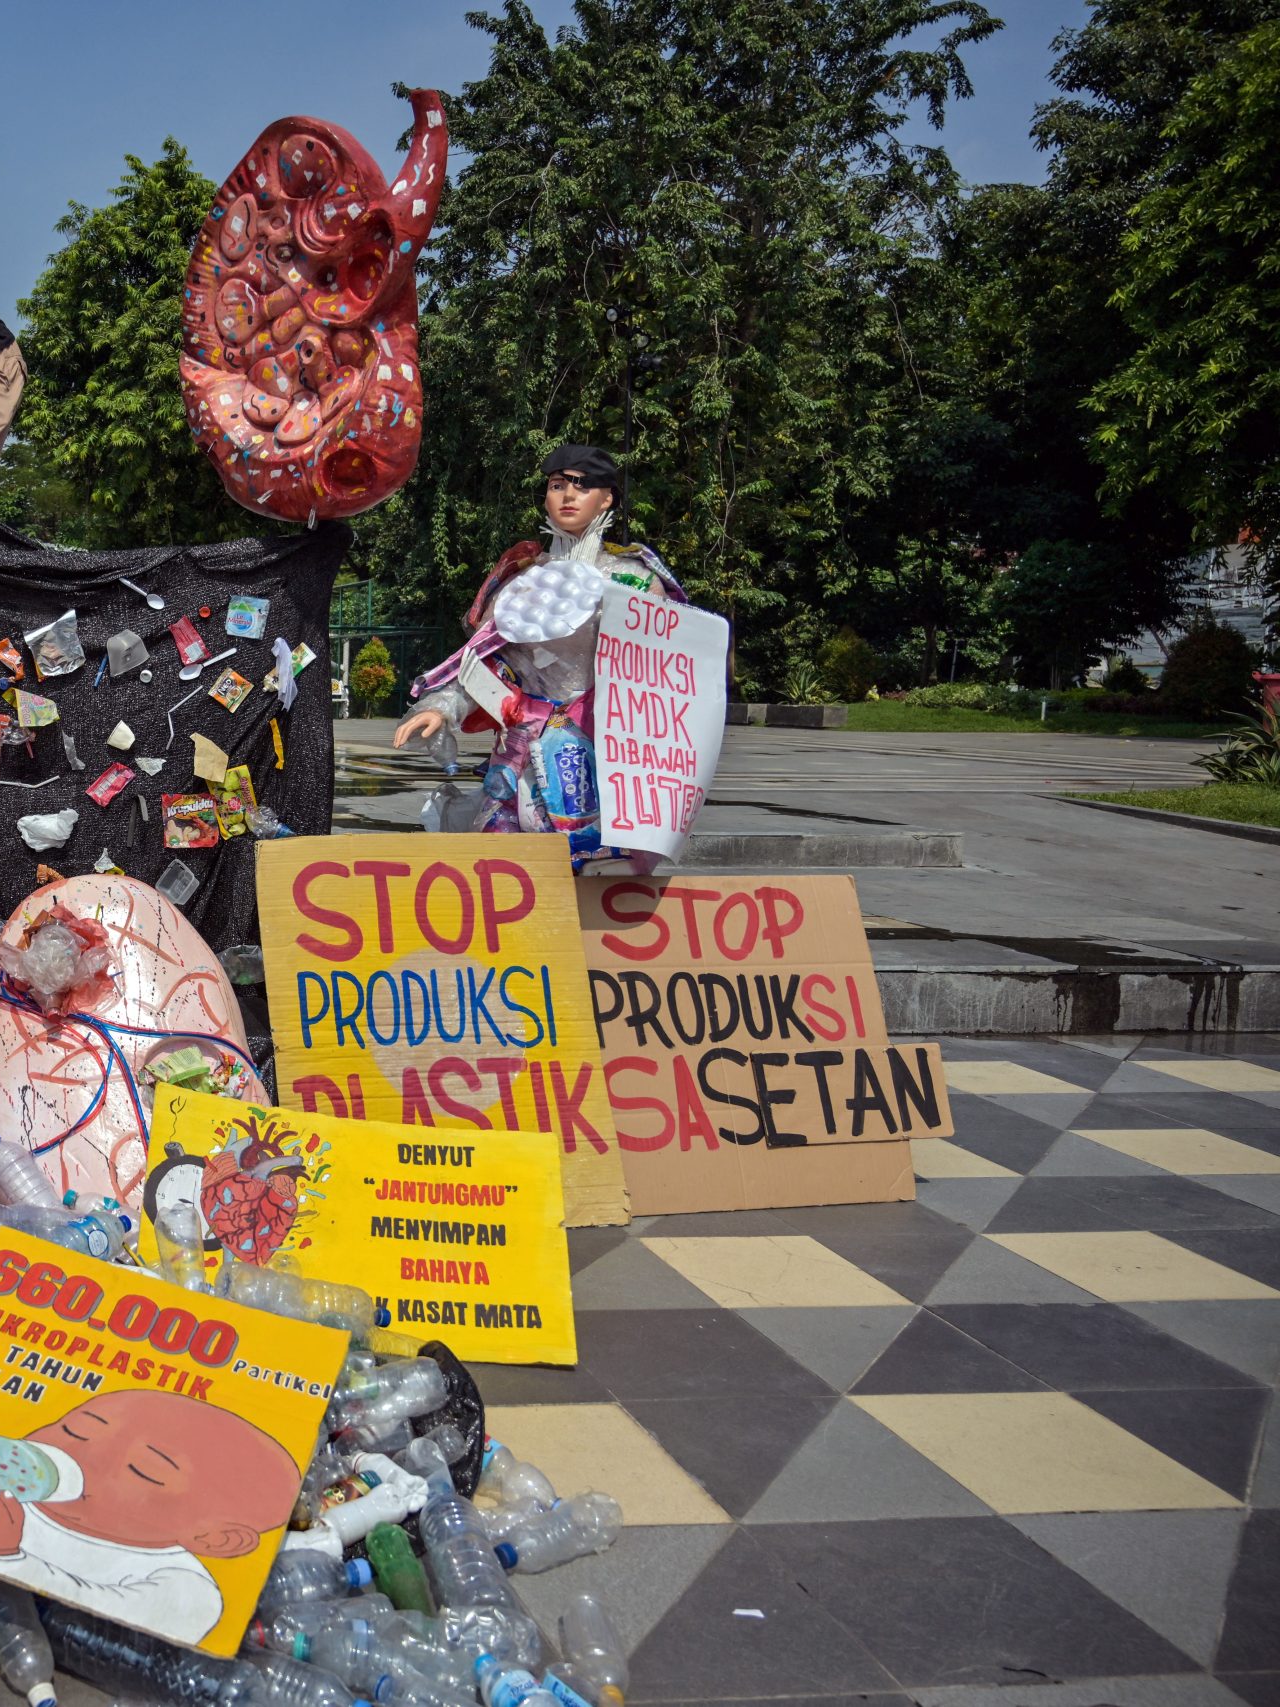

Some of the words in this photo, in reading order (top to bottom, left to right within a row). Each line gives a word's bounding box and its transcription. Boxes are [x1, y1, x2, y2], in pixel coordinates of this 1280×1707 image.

[625, 596, 679, 640] STOP
[597, 633, 696, 696] PRODUKSI
[606, 683, 692, 748] AMDK
[293, 859, 536, 962] STOP
[601, 882, 805, 961] STOP
[297, 965, 557, 1049] PRODUKSI
[587, 969, 866, 1049] PRODUKSI
[398, 1143, 475, 1168] DENYUT
[370, 1215, 506, 1246] MENYIMPAN
[400, 1257, 490, 1286] BAHAYA
[397, 1298, 467, 1326] KASAT
[474, 1302, 543, 1329] MATA
[5, 1344, 105, 1393] TAHUN
[231, 1358, 333, 1399] Partikel
